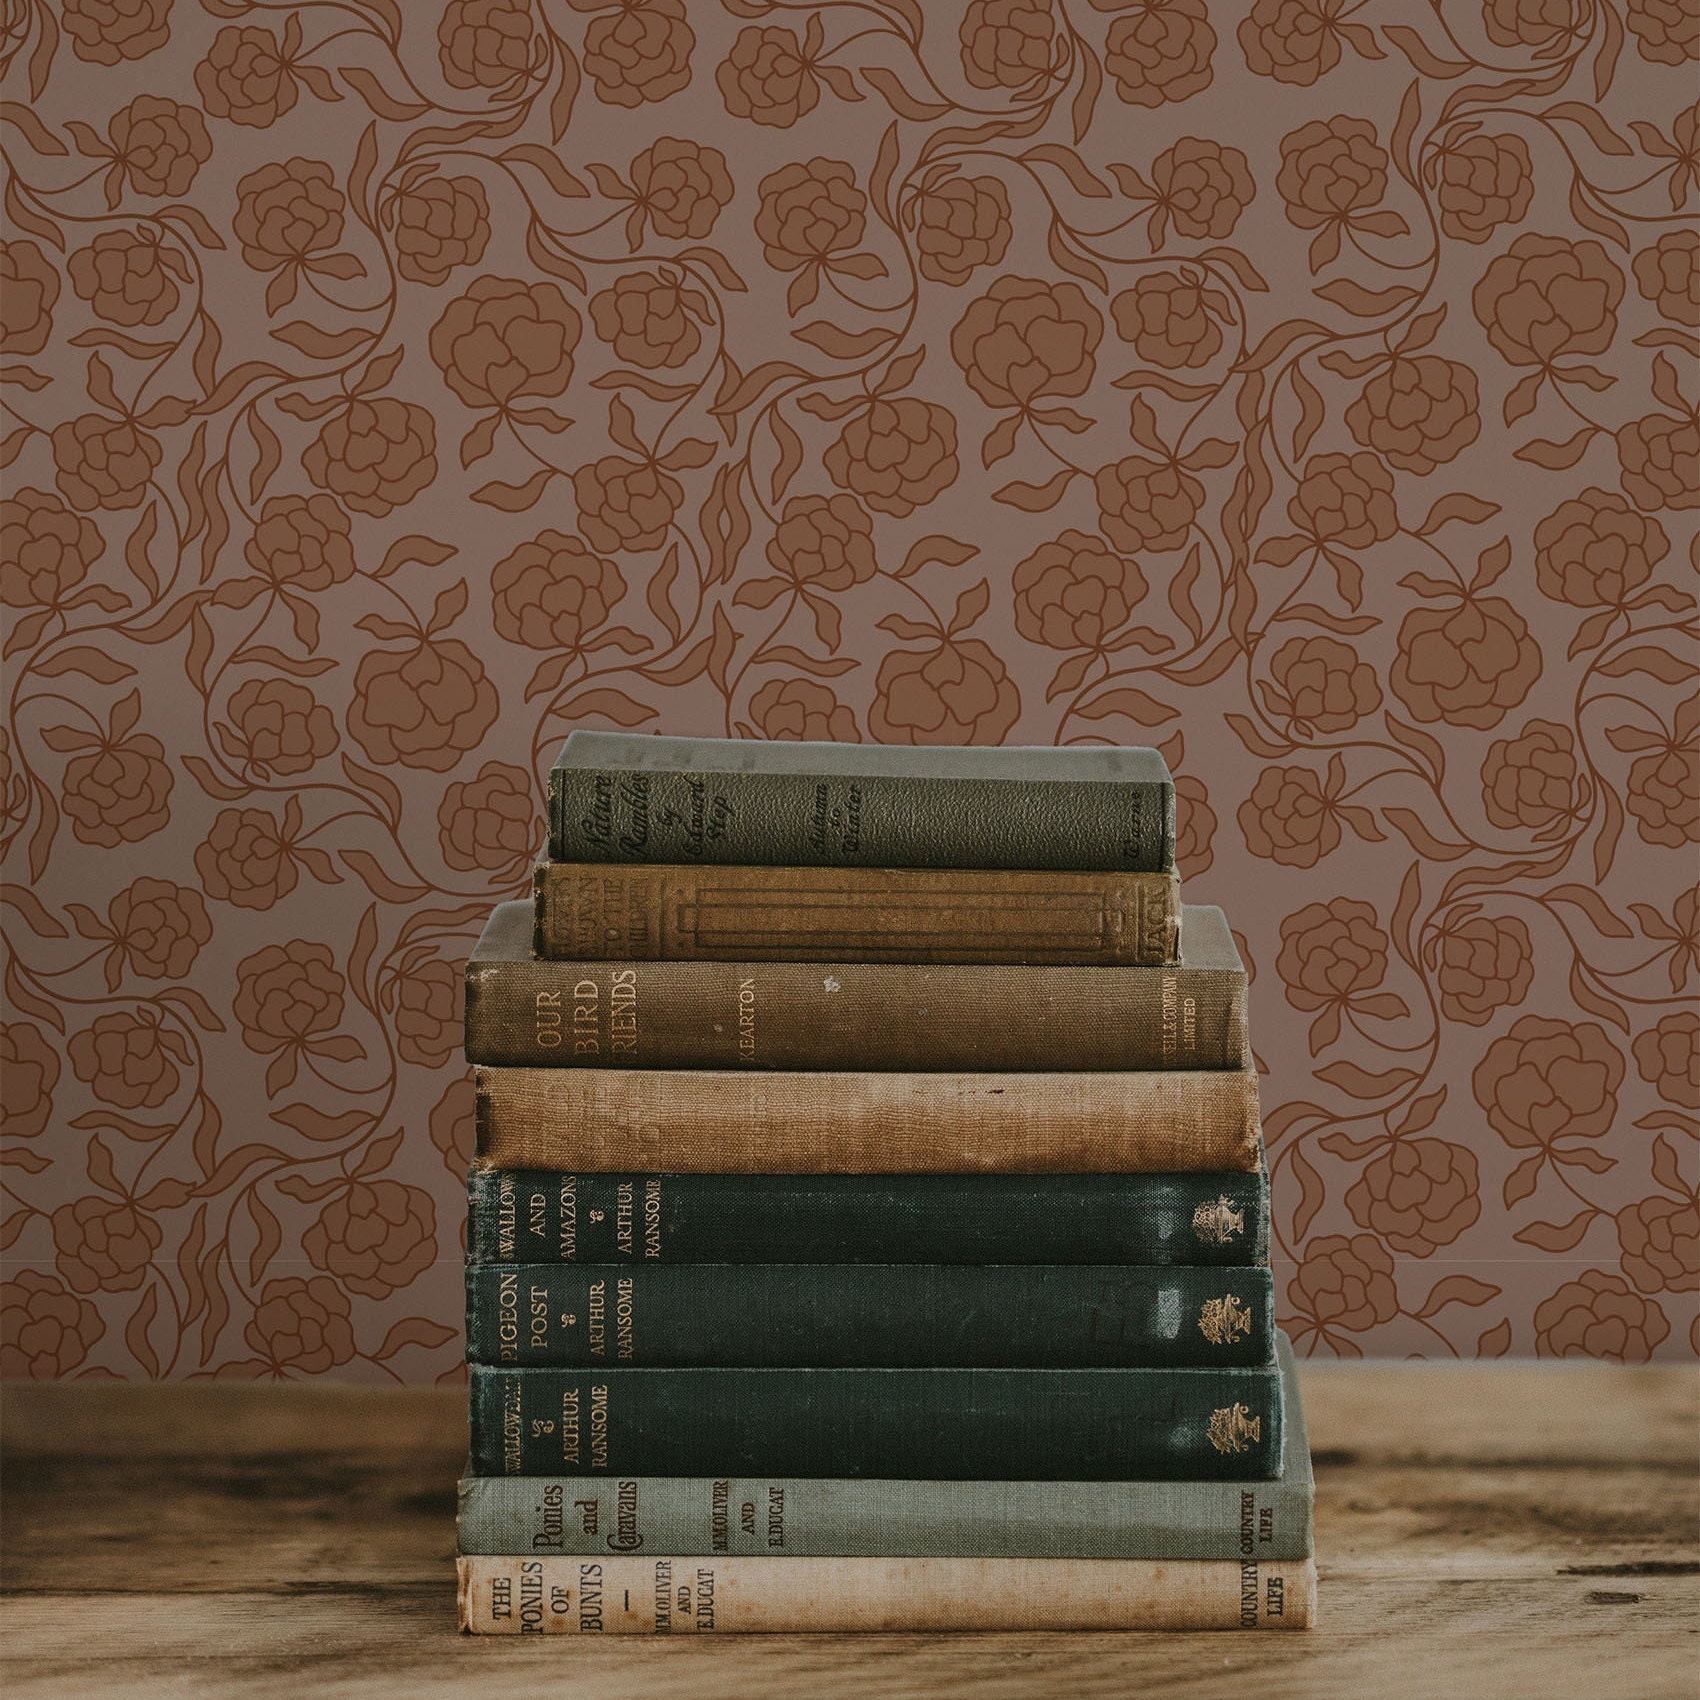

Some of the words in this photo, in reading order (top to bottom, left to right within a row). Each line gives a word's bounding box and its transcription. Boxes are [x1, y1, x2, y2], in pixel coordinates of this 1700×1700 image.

[582, 774, 613, 856] Nature
[619, 773, 649, 858] Rambles
[656, 810, 681, 827] by
[681, 780, 704, 856] Edward
[707, 796, 734, 840] Step
[807, 783, 828, 854] Autumn
[828, 807, 841, 827] to
[841, 783, 862, 854] Winter
[537, 990, 562, 1047] OUR
[575, 980, 600, 1054] BIRD
[612, 970, 637, 1063] RIENDS
[740, 978, 755, 1061] KEARTON
[1163, 976, 1177, 1020] COMPANY
[1163, 1022, 1177, 1031] &
[1184, 998, 1196, 1050] LIMITED
[530, 1193, 546, 1238] AND
[561, 1176, 576, 1260] AMAZONS
[618, 1182, 633, 1254] ARTHUR
[645, 1180, 662, 1257] RANSOME
[500, 1272, 518, 1361] PIGEON
[531, 1286, 548, 1348] POST
[590, 1280, 605, 1356] ARTHUR
[617, 1278, 635, 1359] RANSOME
[563, 1388, 579, 1464] ARTHUR
[591, 1385, 608, 1467] RANSOME
[533, 1485, 564, 1549] Ponies
[574, 1499, 598, 1535] and
[606, 1481, 643, 1551] Caravans
[741, 1502, 755, 1535] AND
[1241, 1490, 1254, 1554] COUNTRY
[1260, 1508, 1273, 1542] LIFE
[492, 1578, 511, 1620] THE
[519, 1562, 543, 1634] PONIES
[550, 1587, 569, 1614] OF
[580, 1564, 604, 1631] BUNTS
[677, 1586, 692, 1614] AND
[1241, 1560, 1258, 1627] COUNTRY
[1267, 1577, 1283, 1616] LIFE
